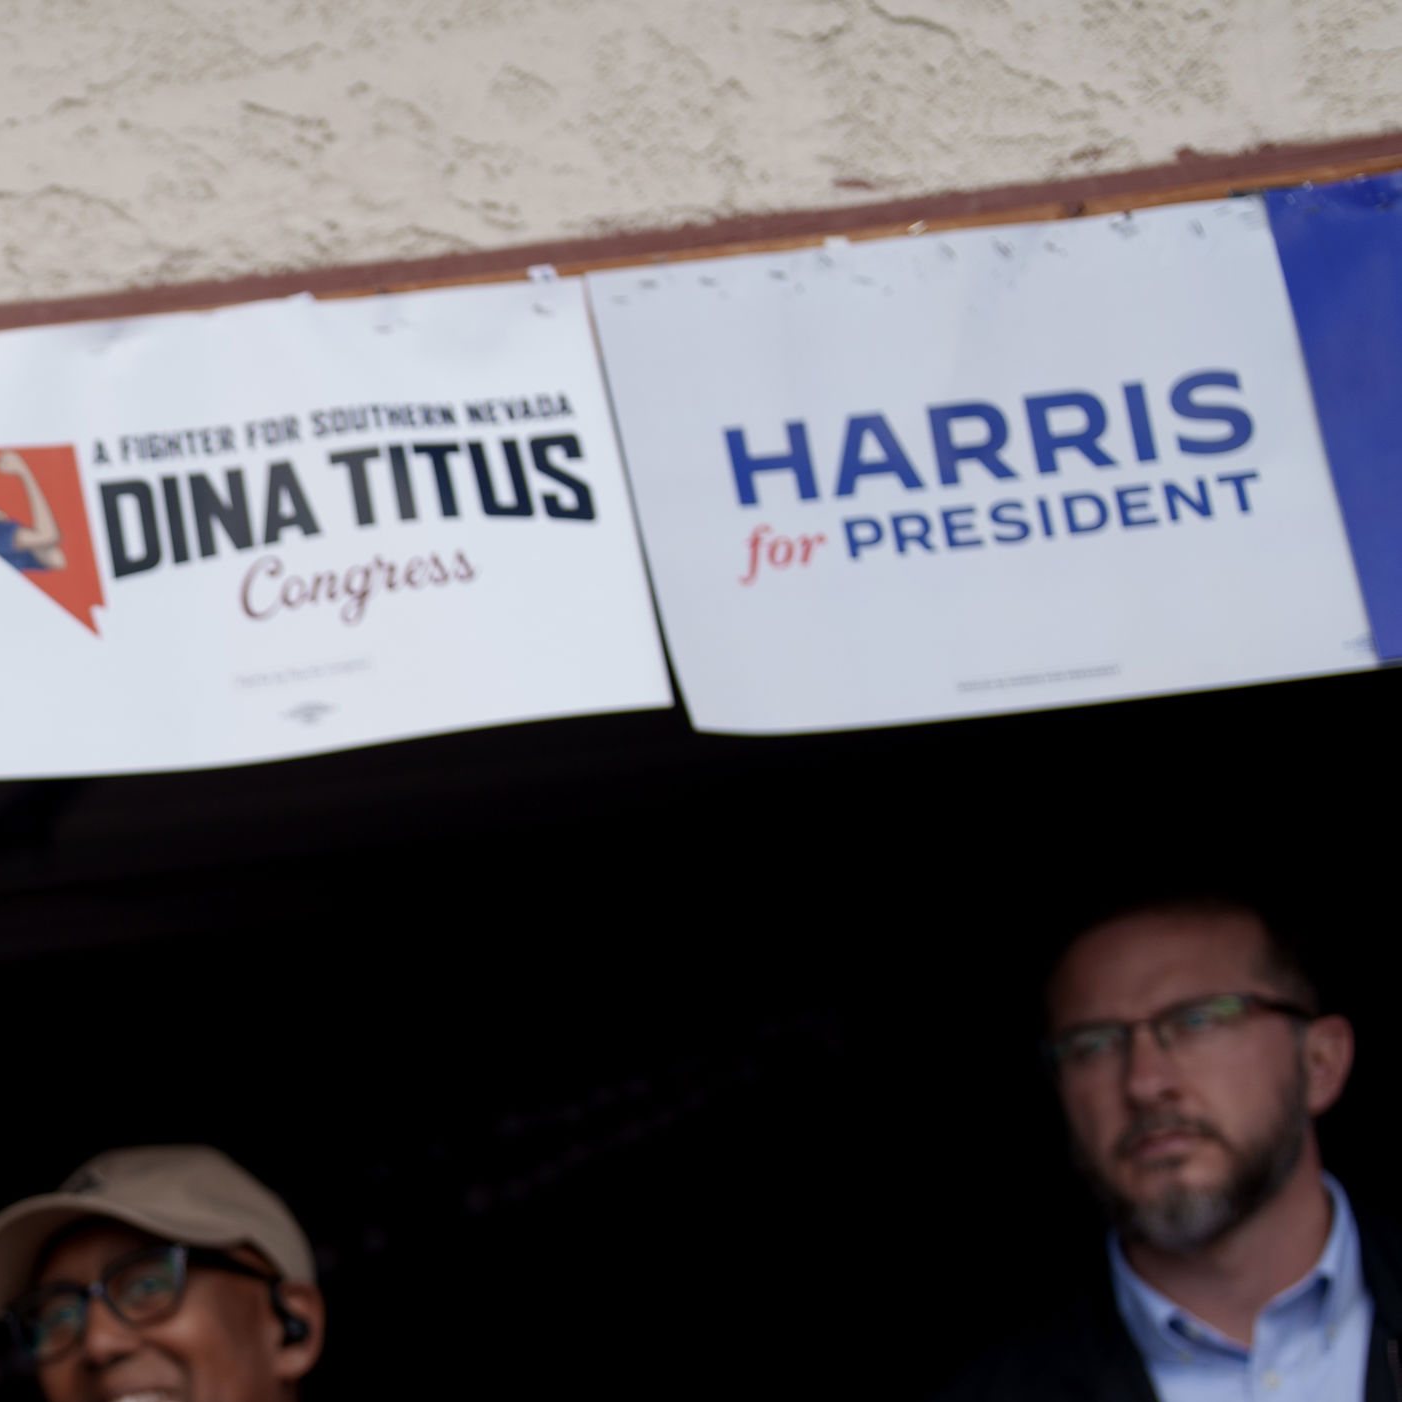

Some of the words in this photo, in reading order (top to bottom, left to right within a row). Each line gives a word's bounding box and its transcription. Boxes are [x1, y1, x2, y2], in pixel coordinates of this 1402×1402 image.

[94, 440, 109, 465] A
[120, 425, 236, 461] FIGHTER
[244, 414, 301, 449] FOR
[310, 400, 457, 439] SOUTHERN
[464, 392, 575, 424] NEVADA
[725, 369, 1255, 508] HARRIS
[98, 457, 323, 580] DINA
[327, 432, 596, 526] TITUS
[739, 526, 827, 586] for
[844, 469, 1261, 560] PRESIDENT
[240, 548, 478, 627] Congress
